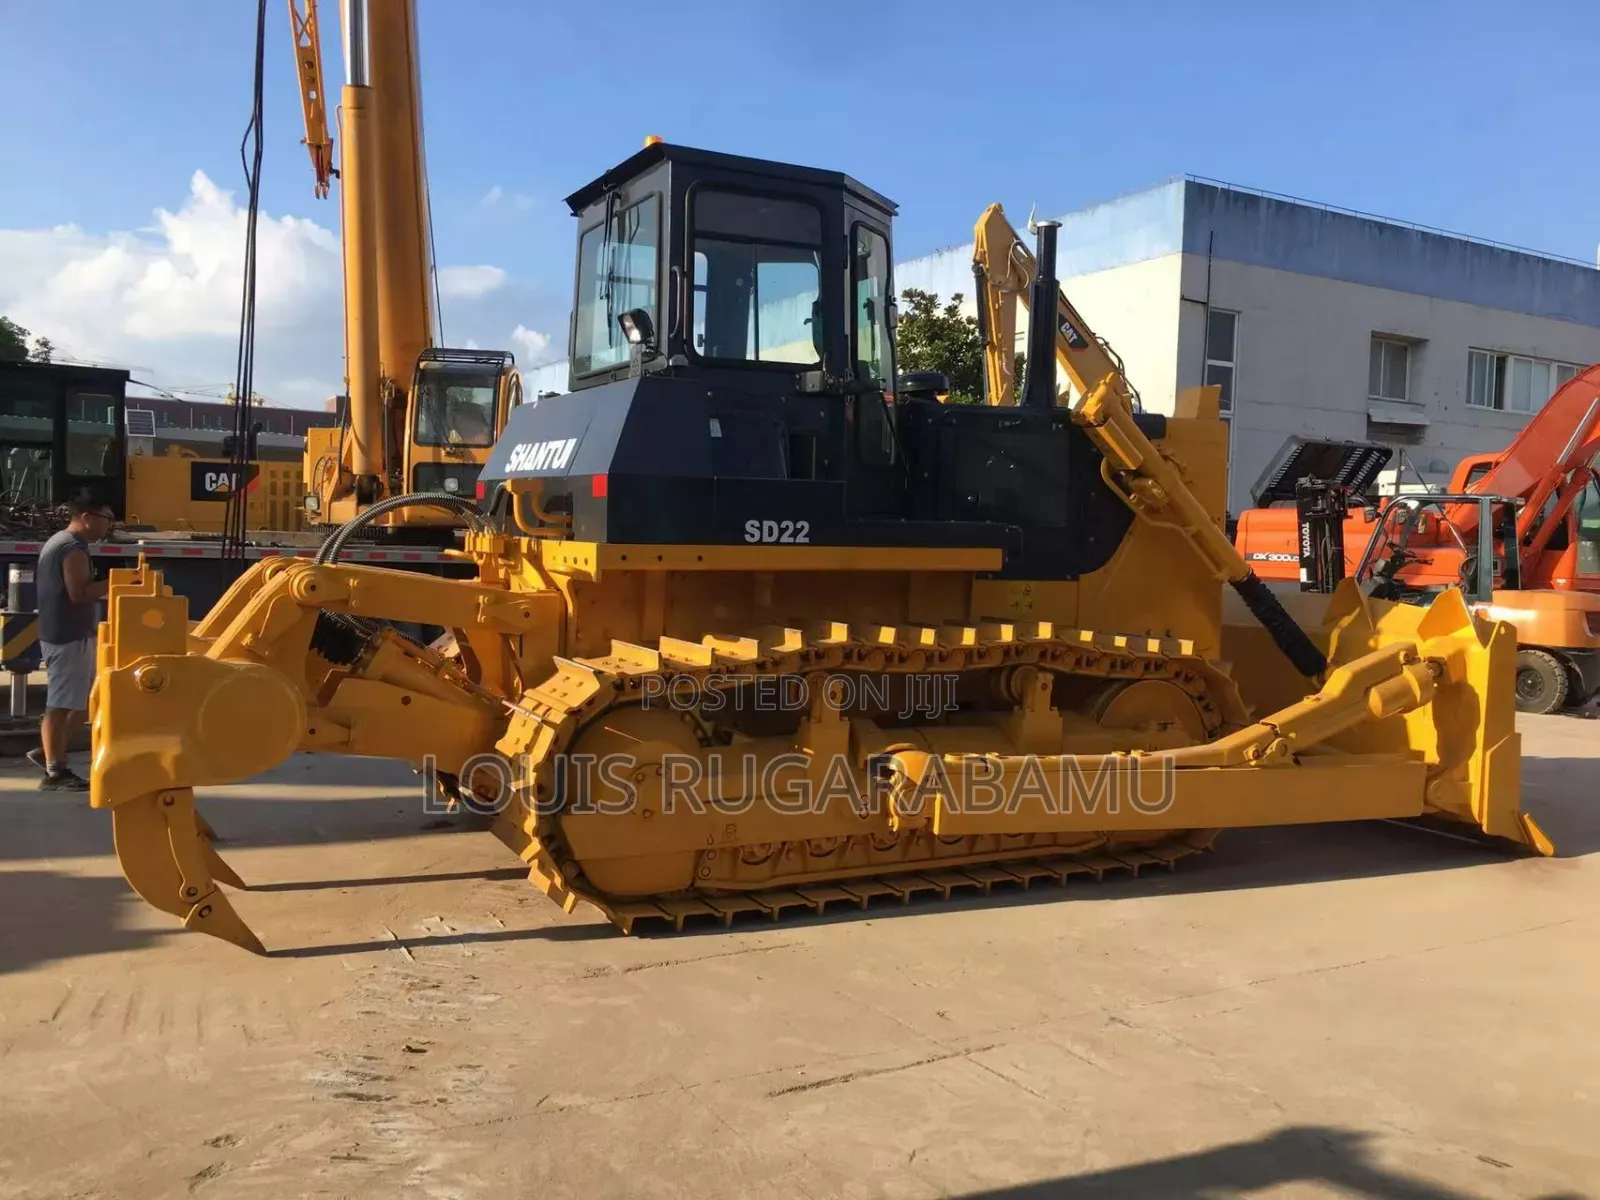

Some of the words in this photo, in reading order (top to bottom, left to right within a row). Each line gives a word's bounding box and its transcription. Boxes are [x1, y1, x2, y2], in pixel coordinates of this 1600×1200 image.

[1061, 322, 1078, 343] CAT
[505, 438, 578, 473] SHANTUI
[744, 519, 810, 544] SD22
[1302, 522, 1311, 558] TOYOTA
